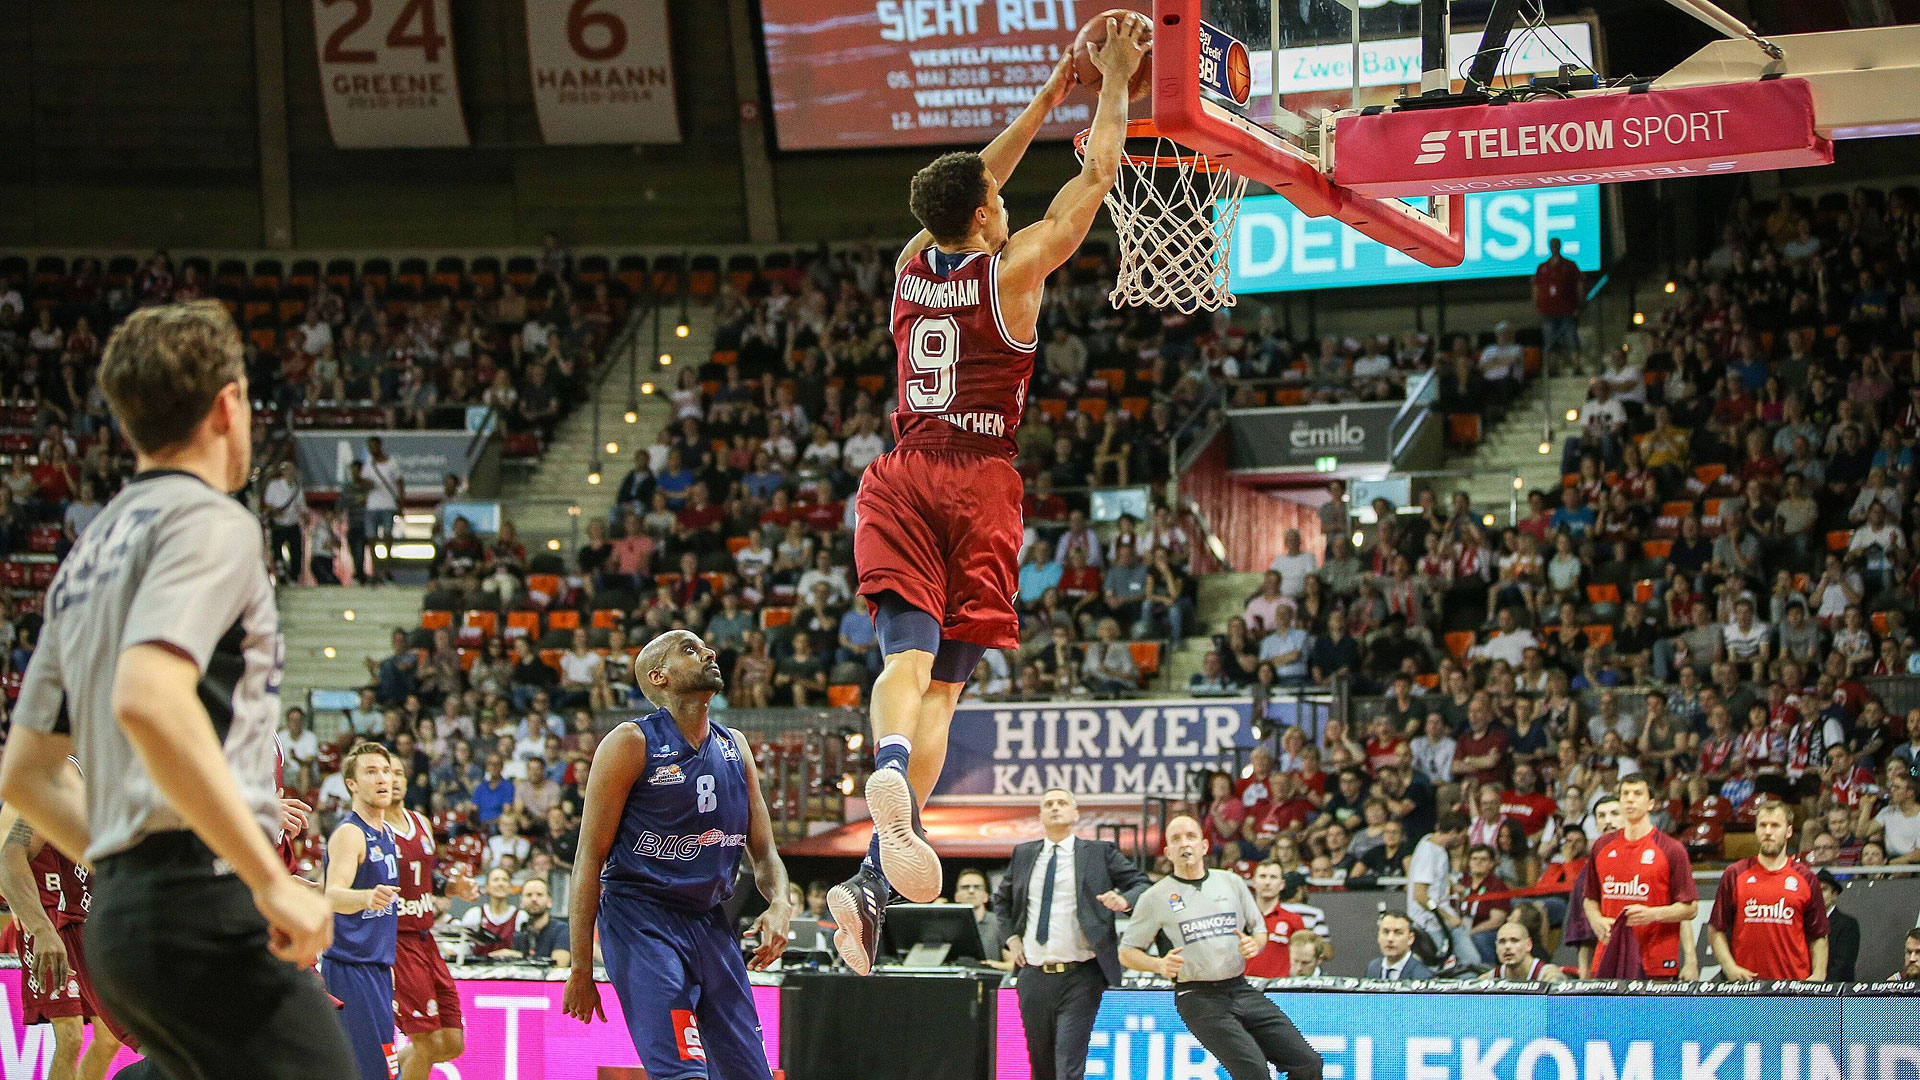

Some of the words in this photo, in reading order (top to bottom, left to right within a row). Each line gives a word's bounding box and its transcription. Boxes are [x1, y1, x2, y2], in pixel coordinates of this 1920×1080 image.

[324, 0, 446, 62] 24
[567, 0, 628, 62] 6
[876, 0, 984, 42] SIEHT
[996, 0, 1078, 35] ROT
[909, 45, 1046, 67] VIERTELFINALE
[332, 73, 447, 95] GREENE
[537, 67, 667, 89] HAMANN
[915, 69, 947, 86] MAI
[949, 67, 991, 86] 2018
[1003, 64, 1051, 84] 20:30
[917, 111, 948, 128] MAI
[950, 108, 993, 127] 2018
[1053, 104, 1090, 123] UHR
[1458, 120, 1614, 160] TELEKOM
[1622, 110, 1730, 148] SPORT
[1238, 190, 1581, 279] DEFSE
[900, 274, 980, 309] CUNNINGHAM
[906, 314, 960, 412] 9
[937, 412, 1006, 438] NCHEN
[993, 707, 1242, 760] HIRMER
[696, 774, 718, 814] 8
[992, 762, 1103, 795] KANN
[1113, 761, 1234, 794] MAN
[632, 830, 703, 861] BLG
[1788, 980, 1834, 993] BayernLB
[1871, 981, 1916, 993] BayernLB
[1267, 1036, 1654, 1080] ELEKOM
